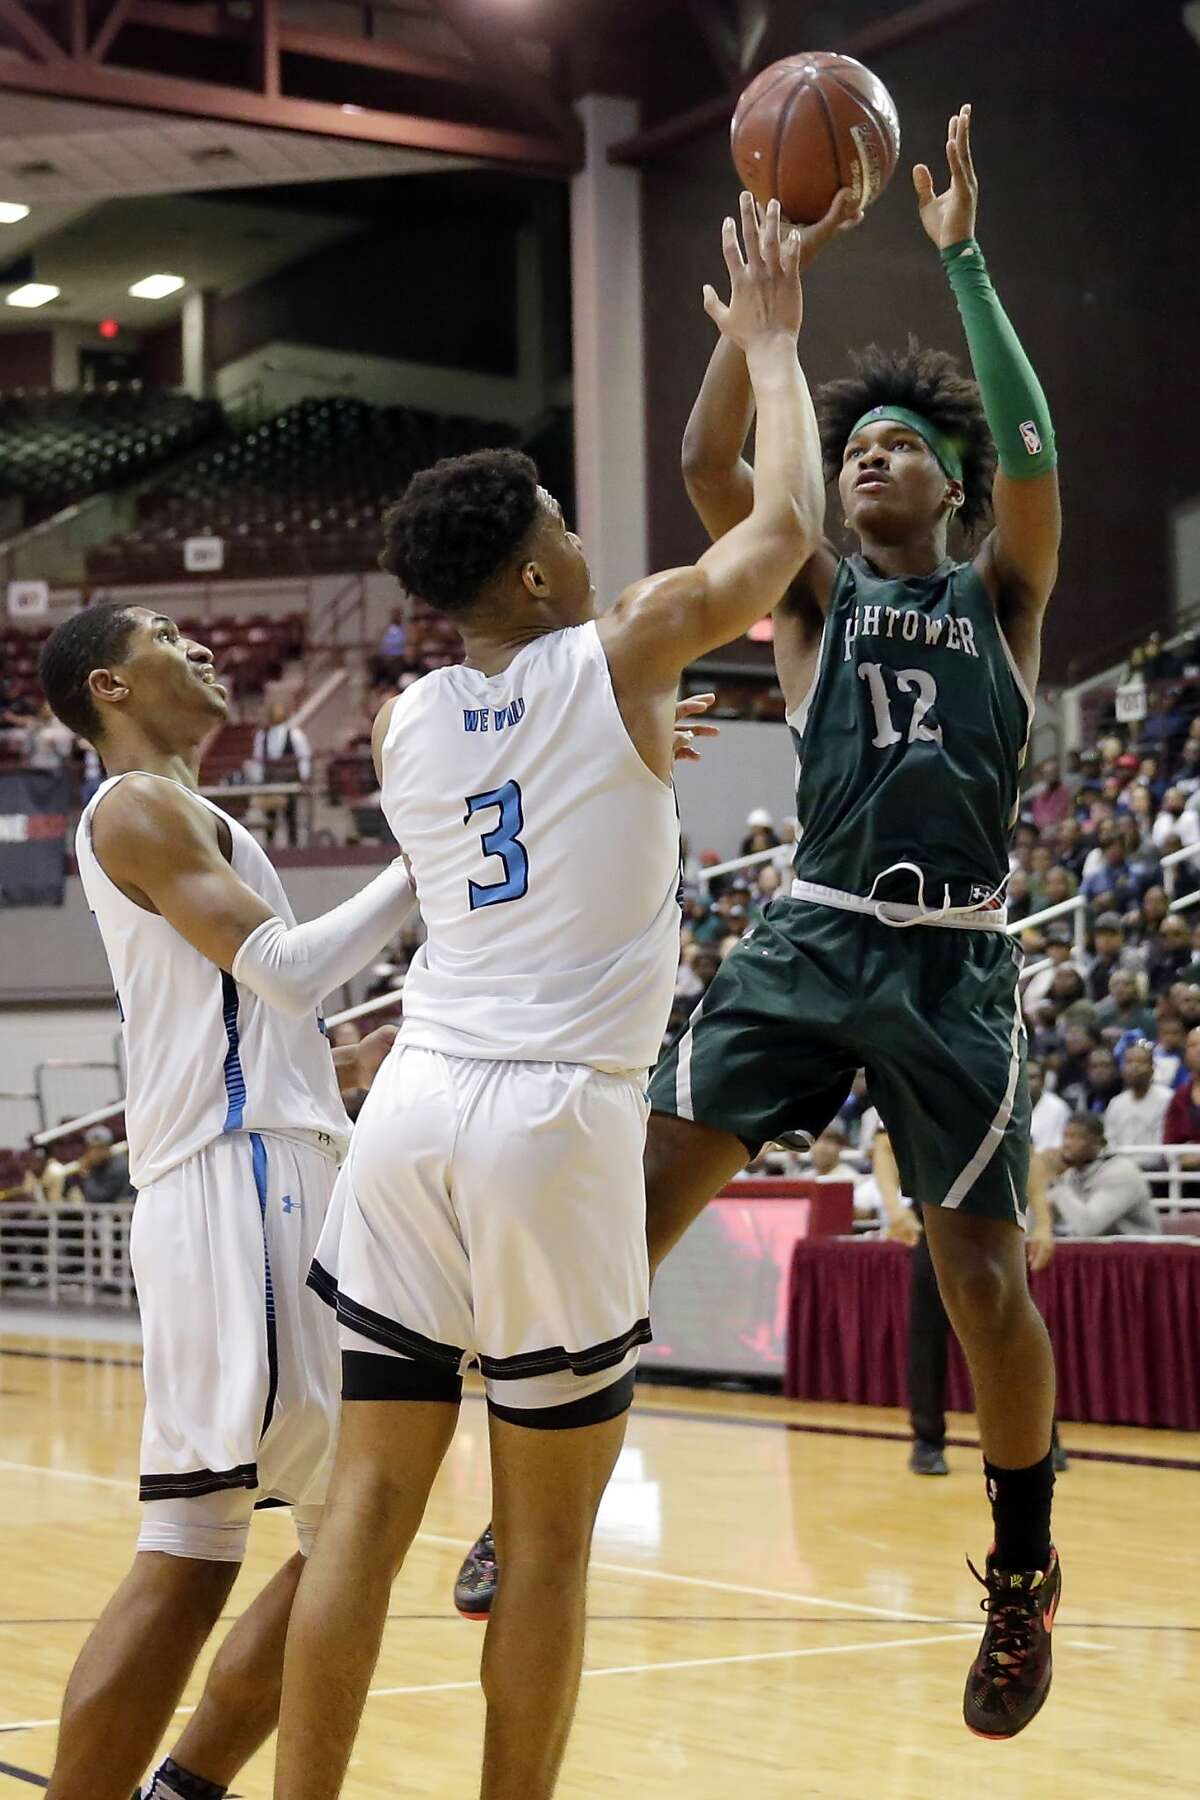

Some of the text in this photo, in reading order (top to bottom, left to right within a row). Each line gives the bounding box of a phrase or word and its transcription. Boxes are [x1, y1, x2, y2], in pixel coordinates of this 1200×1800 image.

[463, 708, 489, 732] WE
[858, 662, 943, 748] 12
[463, 779, 529, 911] 3
